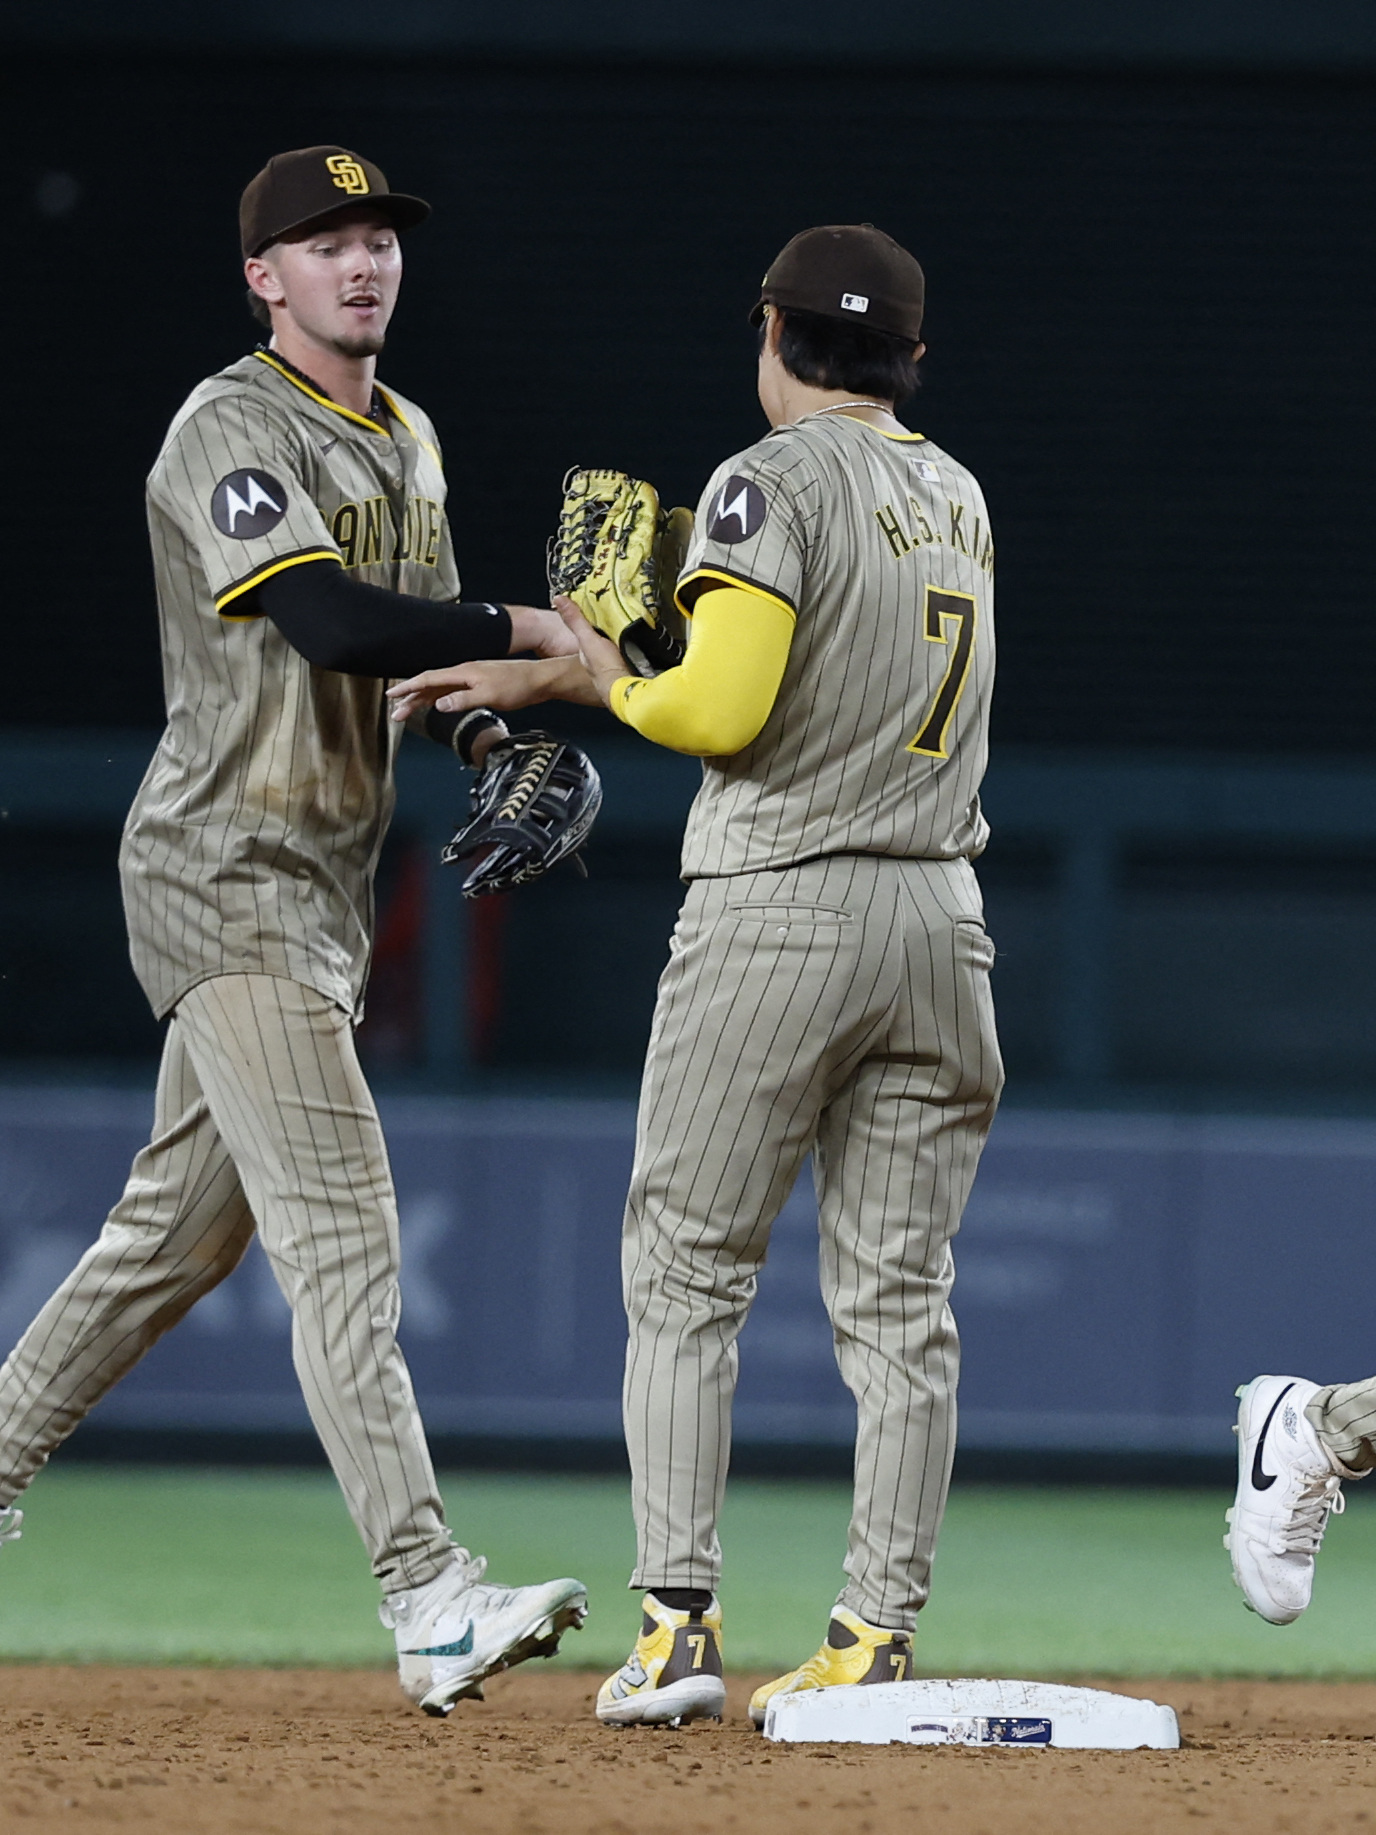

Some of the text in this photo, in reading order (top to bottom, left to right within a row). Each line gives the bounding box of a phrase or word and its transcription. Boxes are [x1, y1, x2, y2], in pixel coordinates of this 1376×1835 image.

[320, 495, 389, 569] AN
[905, 584, 978, 759] 7
[687, 1635, 706, 1669] 7
[890, 1654, 906, 1682] 7
